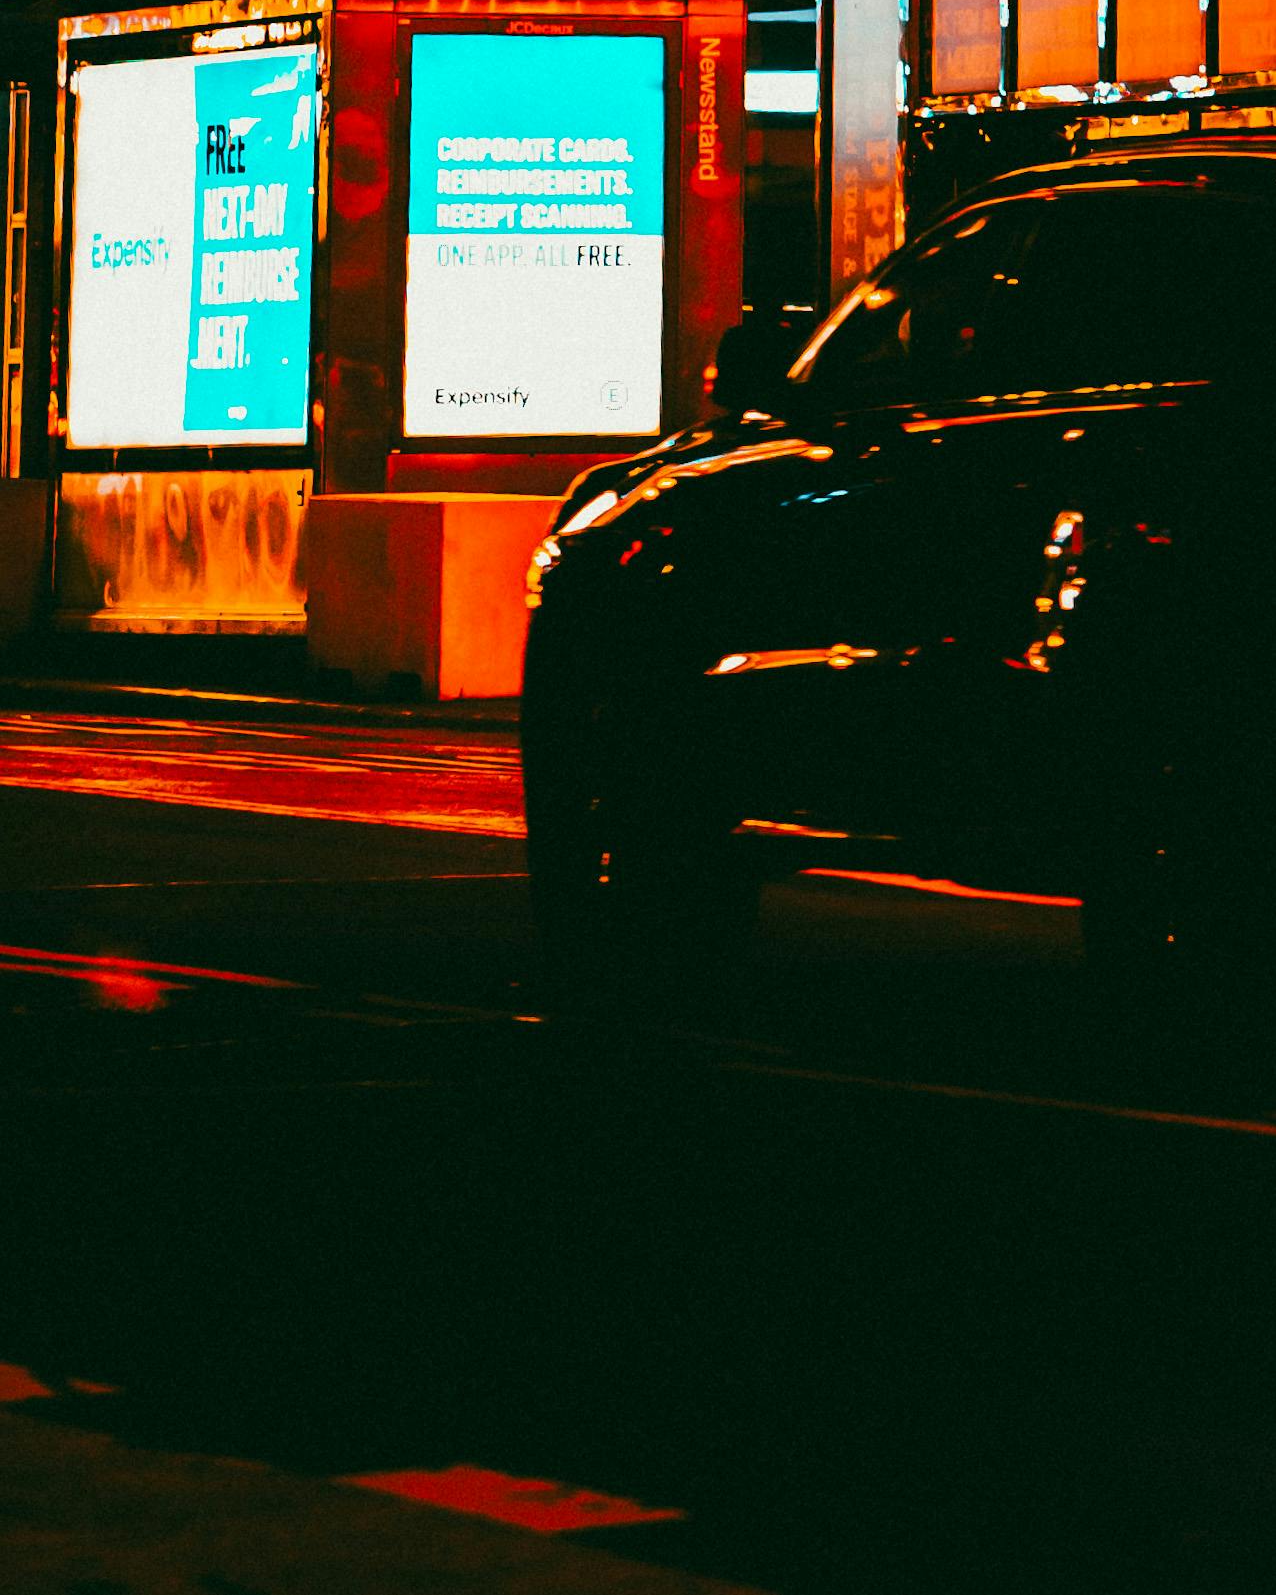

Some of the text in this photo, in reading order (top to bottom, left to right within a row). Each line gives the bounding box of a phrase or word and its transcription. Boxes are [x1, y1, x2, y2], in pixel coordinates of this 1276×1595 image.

[506, 20, 574, 36] JCDecaux
[698, 37, 721, 182] Newsstand
[205, 123, 246, 176] FREE
[437, 137, 635, 163] CORPORATE CARDS.
[436, 168, 634, 196] REIMBURSEMENTS.
[203, 183, 289, 241] NEXT-DAY
[436, 202, 518, 229] RECEIPT
[91, 227, 173, 276] Expensify
[437, 243, 477, 268] ONE
[535, 244, 570, 268] ALL
[576, 244, 633, 268] FREE.
[435, 385, 530, 409] Expensify
